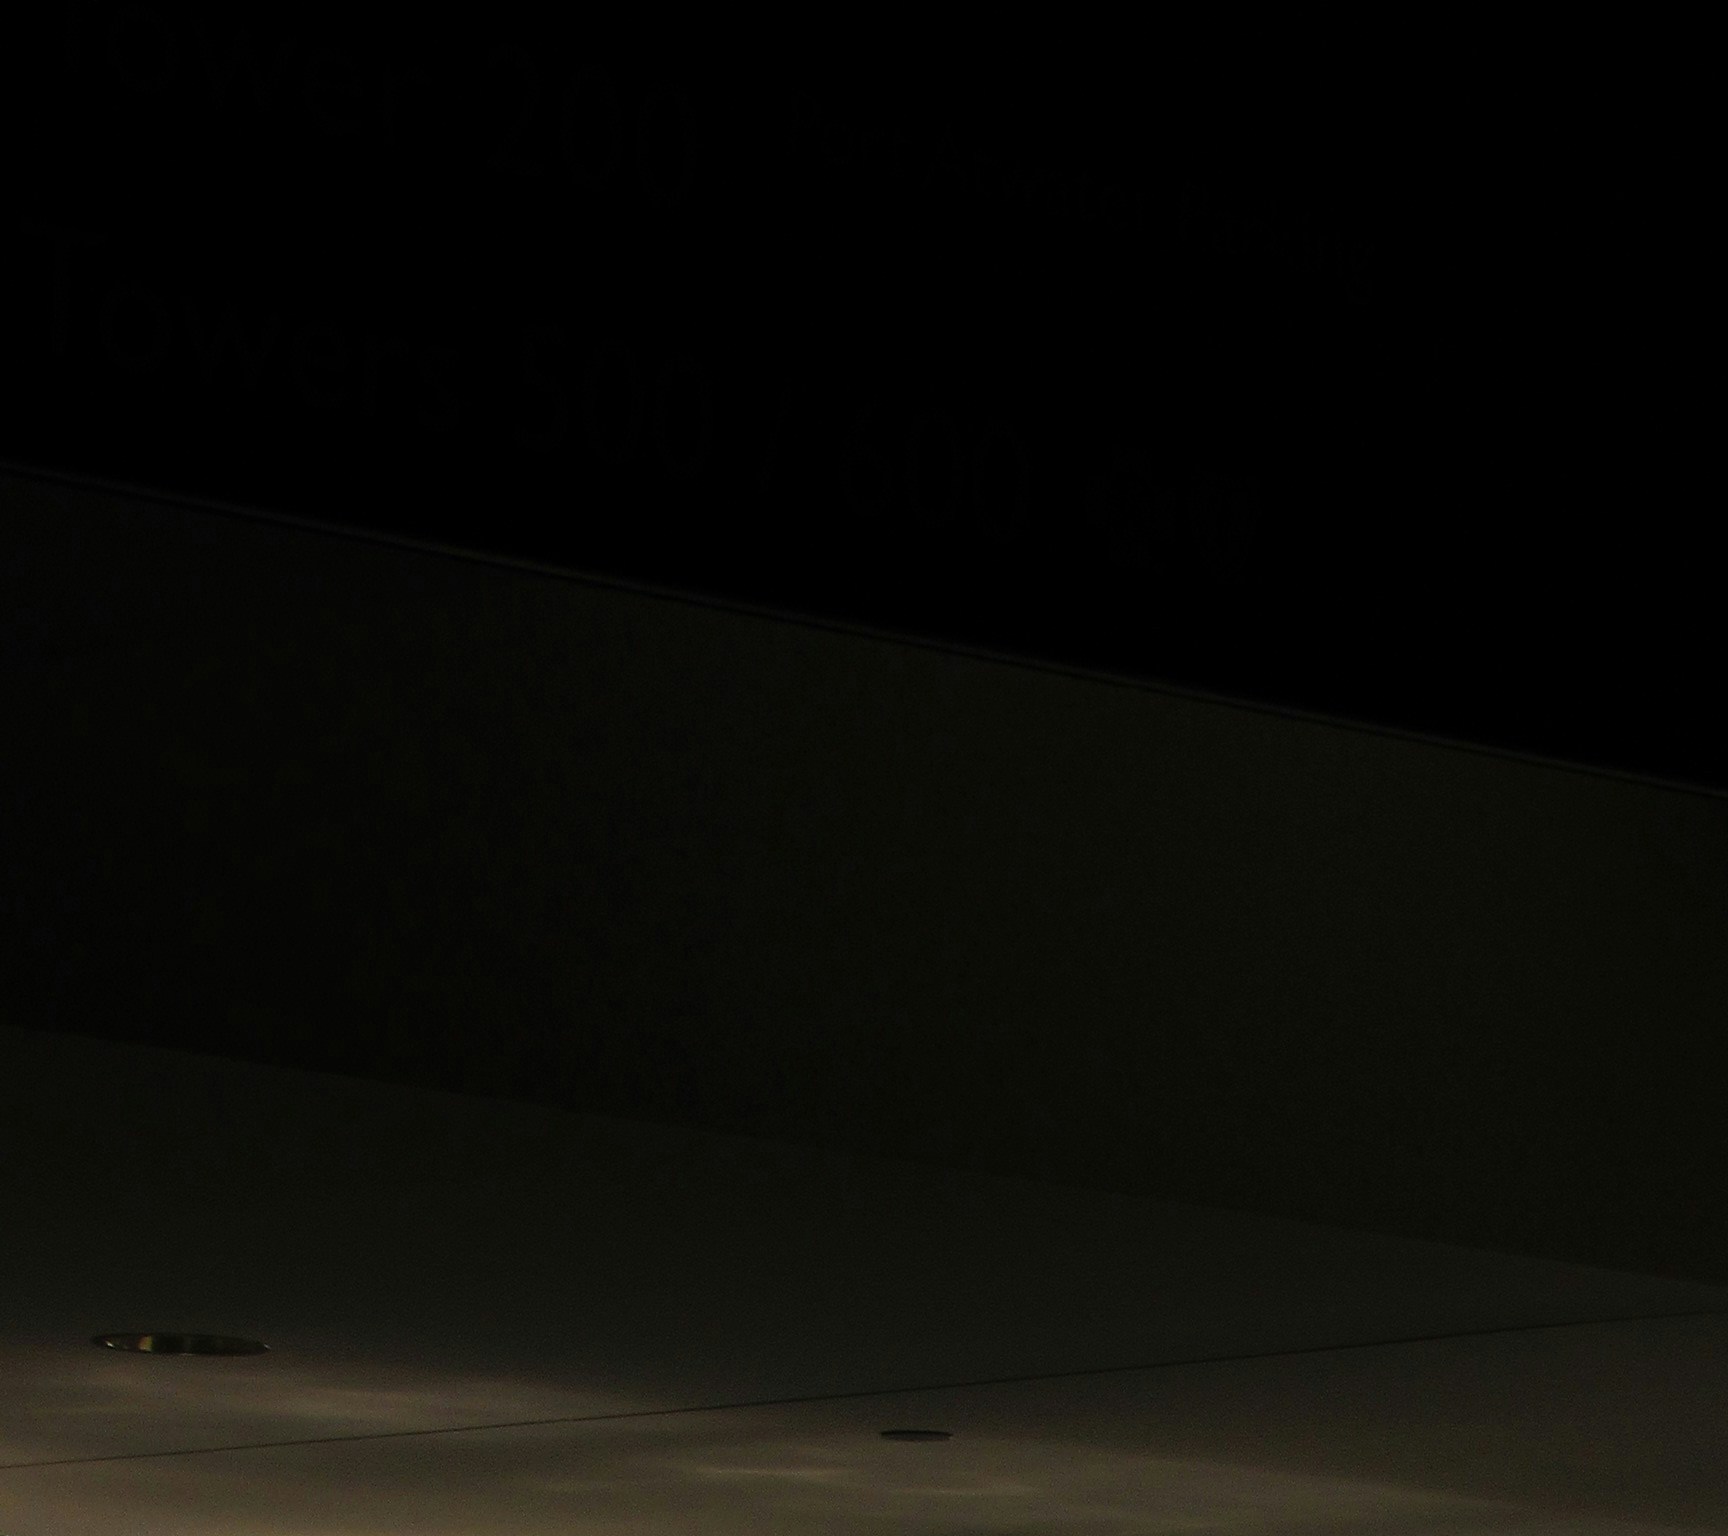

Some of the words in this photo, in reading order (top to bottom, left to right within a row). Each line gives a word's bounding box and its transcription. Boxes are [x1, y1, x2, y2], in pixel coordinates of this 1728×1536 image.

[485, 42, 700, 212] 200
[19, 215, 463, 434] Towers
[510, 323, 714, 482] 500
[836, 399, 1033, 544] 600
